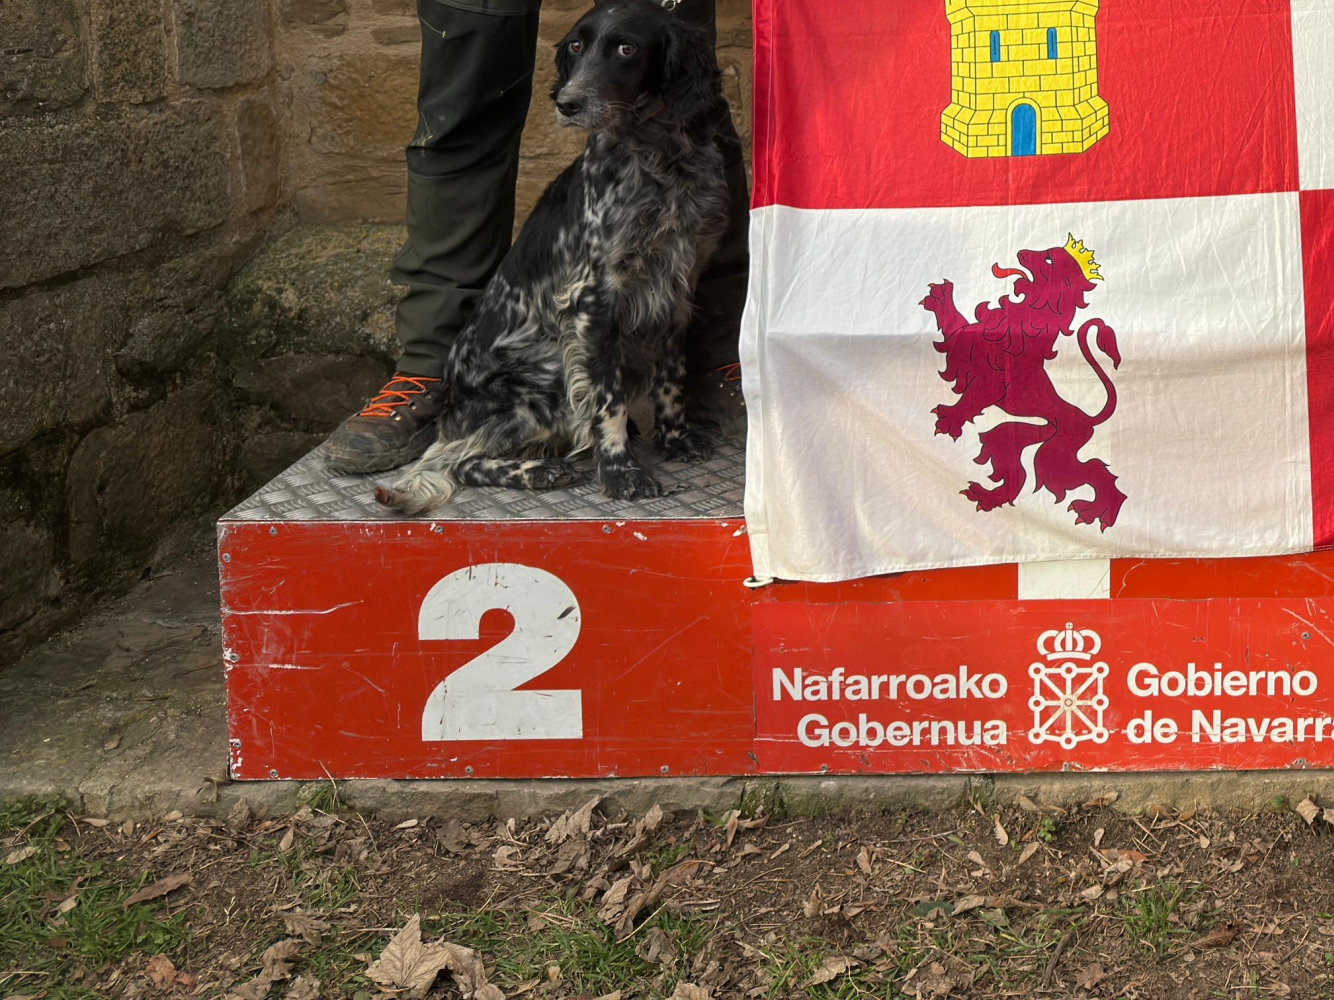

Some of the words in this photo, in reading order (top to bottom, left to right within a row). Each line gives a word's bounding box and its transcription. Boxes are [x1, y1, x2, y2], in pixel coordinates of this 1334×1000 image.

[417, 562, 583, 742] 2
[772, 666, 1007, 701] Nafarroako
[1127, 662, 1318, 697] Gobierno
[797, 713, 1007, 748] Gobernua
[1127, 711, 1177, 744] de
